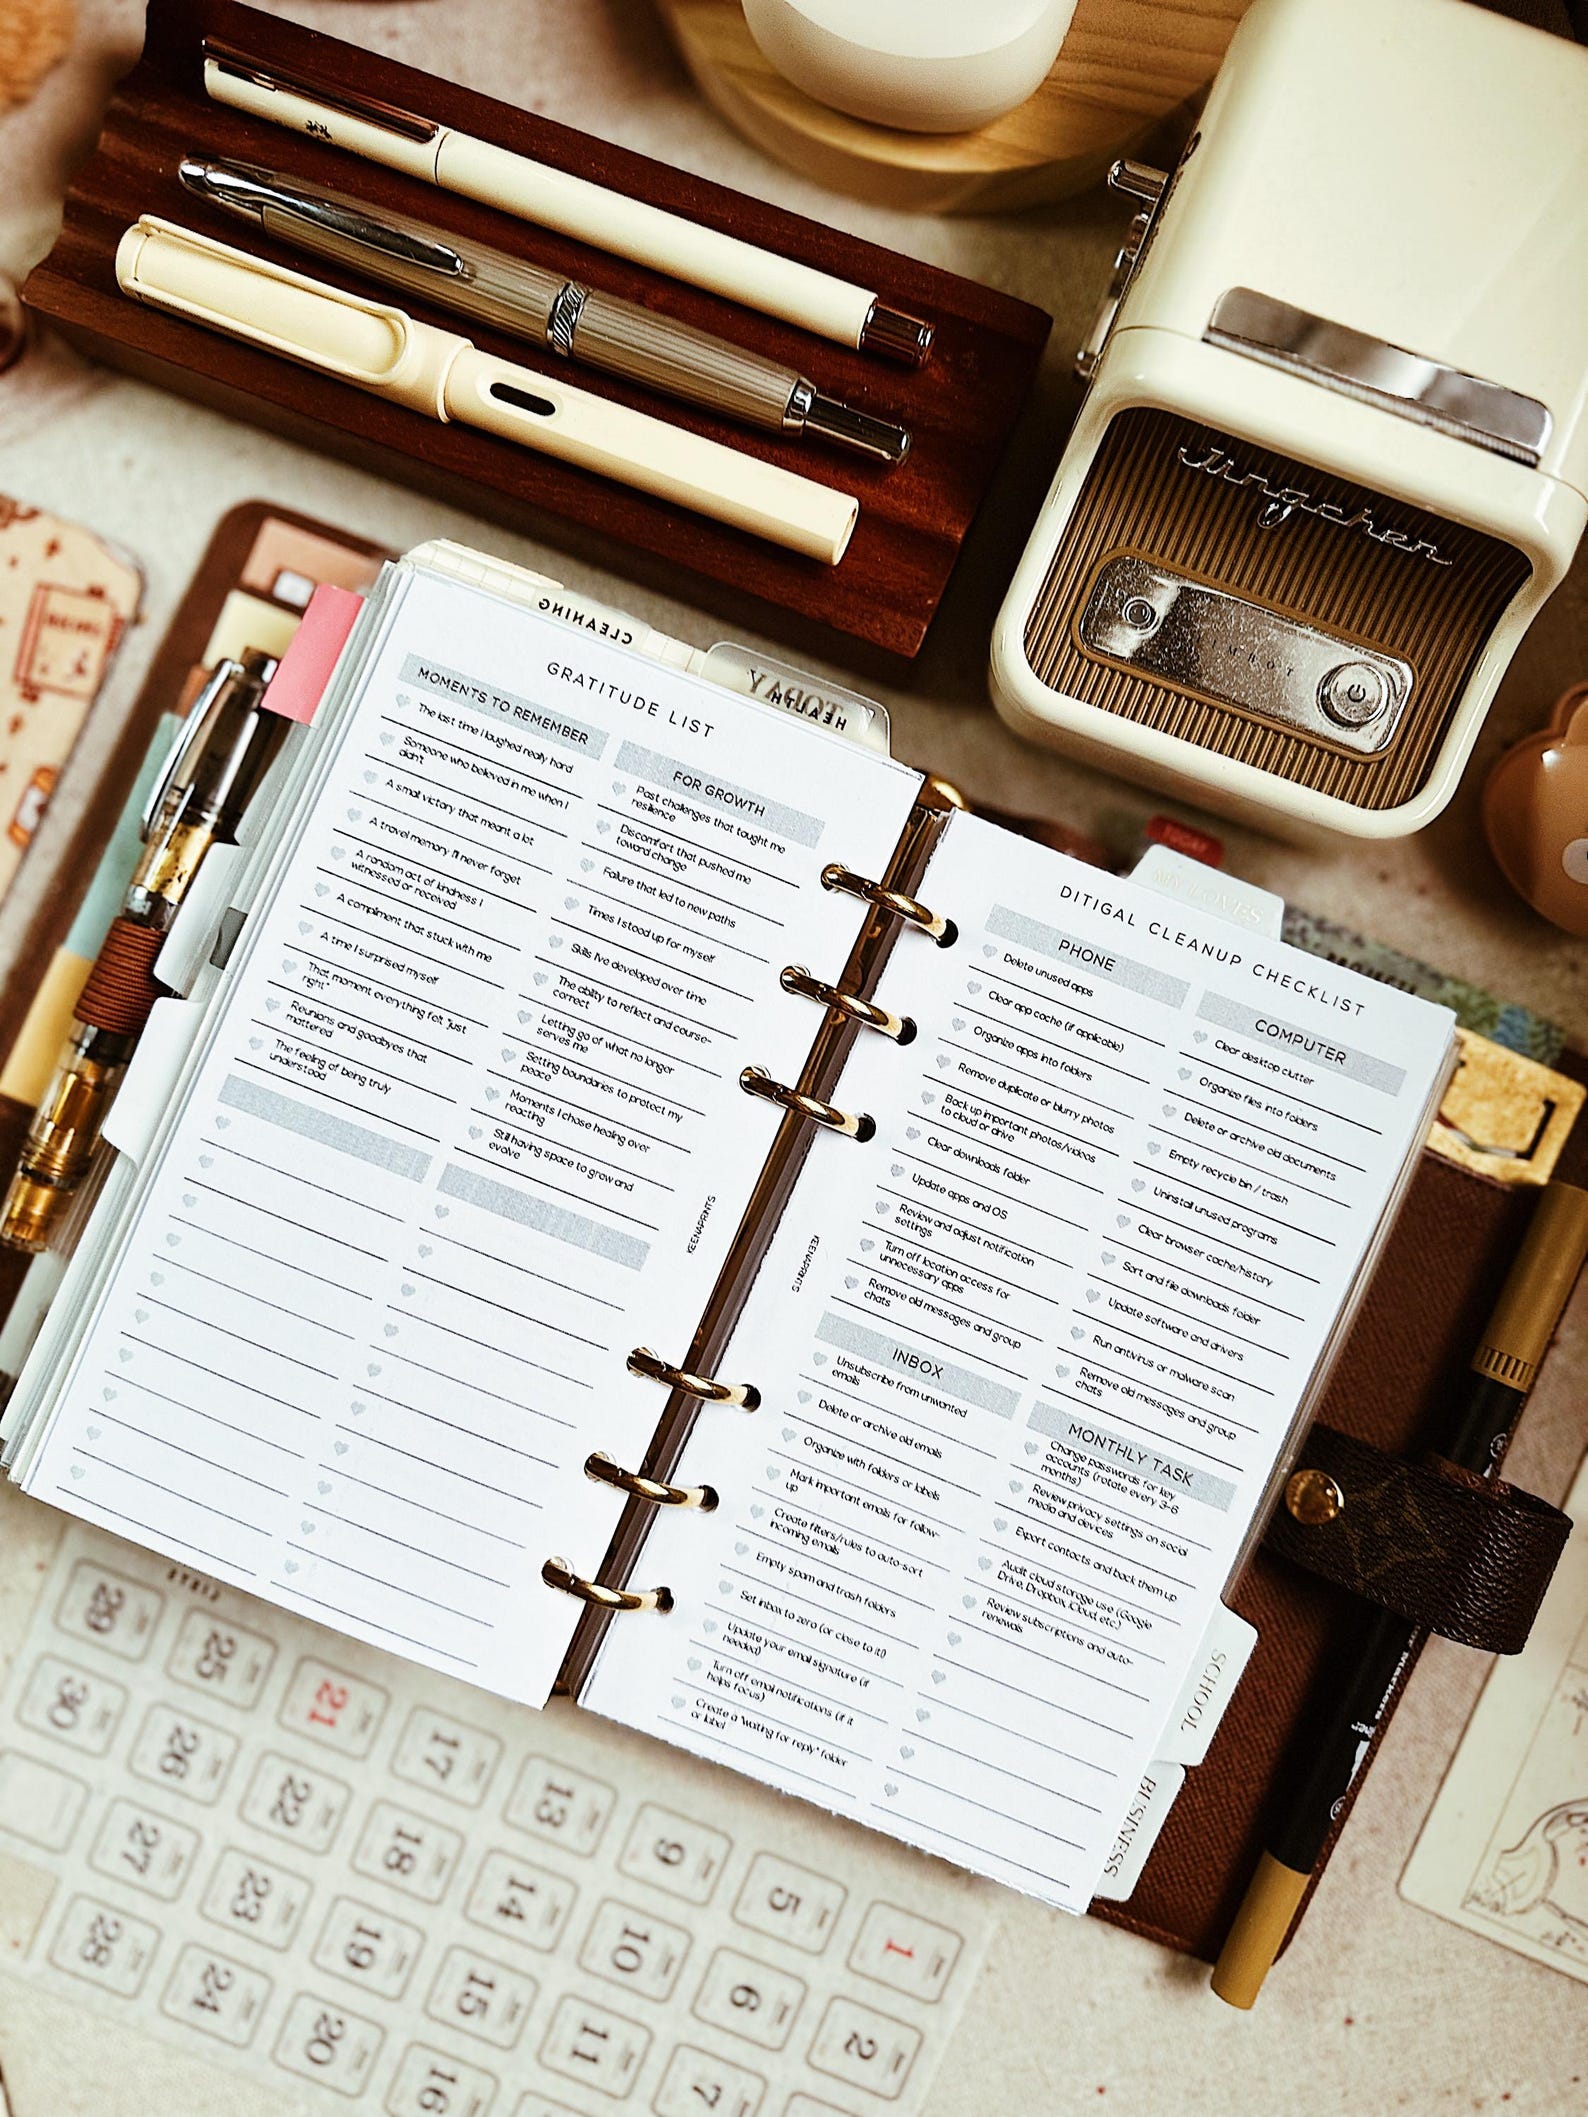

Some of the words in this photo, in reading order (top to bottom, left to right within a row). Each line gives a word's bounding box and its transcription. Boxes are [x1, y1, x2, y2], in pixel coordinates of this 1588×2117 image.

[418, 665, 489, 705] MOMENTS
[490, 694, 512, 714] TO
[511, 703, 590, 746] REMEMBER
[545, 660, 661, 718] GRATITUDE
[666, 708, 716, 739] LIST
[418, 701, 437, 718] The
[436, 711, 456, 727] last
[457, 719, 480, 735] time
[483, 729, 523, 753] laughed
[548, 756, 575, 774] hard
[670, 768, 704, 793] FOR
[702, 782, 767, 818] GROWTH
[635, 784, 661, 804] Past
[712, 816, 735, 834] that
[735, 826, 769, 848] taught
[768, 841, 786, 855] me
[615, 835, 652, 857] toward
[650, 851, 688, 873] change
[619, 822, 675, 854] Discomfort
[675, 846, 698, 864] that
[696, 856, 737, 879] pushed
[734, 871, 752, 886] me
[635, 879, 658, 897] that
[657, 888, 675, 903] led
[673, 895, 687, 908] to
[685, 901, 709, 917] new
[706, 910, 737, 929] paths
[1002, 952, 1035, 973] Delete
[1034, 967, 1072, 988] unused
[1069, 981, 1094, 998] apps
[1056, 937, 1118, 974] PHONE
[1058, 883, 1136, 928] DITIGAL
[1146, 920, 1244, 967] CLEANUP
[1250, 961, 1367, 1017] CHECKLIST
[285, 1012, 334, 1039] mattered
[289, 999, 335, 1026] Reunions
[336, 1020, 357, 1035] and
[355, 1028, 405, 1054] goodbyes
[405, 1047, 428, 1064] that
[535, 1026, 571, 1047] serves
[571, 1040, 589, 1054] me
[540, 1013, 577, 1039] Letting
[574, 1030, 591, 1043] go
[590, 1036, 605, 1046] of
[604, 1040, 630, 1058] what
[629, 1050, 644, 1063] no
[643, 1054, 676, 1075] longer
[1253, 1017, 1348, 1067] COMPUTER
[268, 1053, 327, 1082] understood
[275, 1037, 294, 1054] The
[326, 1062, 341, 1072] of
[339, 1065, 368, 1088] being
[367, 1077, 392, 1096] truly
[519, 1063, 552, 1083] peace
[972, 1024, 1016, 1050] Organize
[1014, 1044, 1039, 1060] apps
[1039, 1052, 1060, 1068] into
[1058, 1060, 1093, 1082] folders
[1213, 1038, 1241, 1056] Clear
[1240, 1051, 1281, 1073] desktop
[1280, 1067, 1315, 1085] clutter
[525, 1050, 561, 1076] Setting
[560, 1064, 615, 1094] boundaries
[615, 1087, 629, 1100] to
[627, 1093, 666, 1116] protect
[666, 1109, 684, 1124] my
[926, 1135, 954, 1153] Clear
[952, 1147, 1002, 1175] downloads
[1001, 1166, 1031, 1185] folder
[1183, 1110, 1216, 1132] Delete
[1215, 1126, 1229, 1136] or
[1228, 1131, 1266, 1152] archive
[1265, 1147, 1283, 1160] old
[1281, 1153, 1337, 1182] documents
[911, 1172, 947, 1195] Update
[946, 1189, 971, 1205] apps
[971, 1199, 993, 1214] and
[990, 1205, 1009, 1221] OS
[1152, 1185, 1195, 1210] Uninstall
[1193, 1204, 1232, 1226] unused
[1229, 1219, 1279, 1246] programs
[1136, 1223, 1165, 1241] Clear
[1107, 1296, 1144, 1319] Update
[1143, 1313, 1190, 1339] software
[1189, 1333, 1211, 1347] and
[1209, 1341, 1244, 1362] drivers
[835, 1354, 896, 1388] Unsubscribe
[894, 1380, 921, 1399] from
[919, 1391, 969, 1419] unwanted
[890, 1346, 945, 1381] INBOX
[817, 1398, 850, 1420] Delete
[849, 1414, 863, 1424] or
[861, 1419, 899, 1440] archive
[897, 1434, 915, 1447] old
[1066, 1421, 1149, 1466] MONTHLY
[1151, 1455, 1195, 1488] TASK
[1014, 1525, 1047, 1548] Export
[1046, 1541, 1092, 1566] contacts
[1092, 1560, 1114, 1575] and
[1111, 1566, 1136, 1586] back
[1136, 1578, 1164, 1597] them
[1163, 1590, 1178, 1603] up
[86, 1581, 126, 1635] 29
[196, 1629, 238, 1680] 25
[47, 1676, 88, 1731] 30
[307, 1679, 349, 1728] 21
[1180, 1648, 1227, 1732] SCHOOL
[159, 1726, 199, 1780] 26
[424, 1730, 462, 1781] 17
[269, 1774, 311, 1828] 22
[535, 1782, 575, 1829] 13
[121, 1820, 160, 1876] 27
[383, 1828, 423, 1876] 18
[654, 1838, 685, 1867] 9
[231, 1869, 271, 1923] 23
[496, 1877, 537, 1921] 14
[767, 1886, 802, 1915] 5
[80, 1914, 122, 1968] 28
[345, 1924, 382, 1971] 19
[612, 1927, 651, 1974] 10
[884, 1939, 915, 1959] 1
[192, 1963, 232, 2014] 24
[457, 1972, 496, 2017] 15
[729, 1984, 760, 2013] 6
[306, 2012, 344, 2066] 20
[571, 2023, 609, 2065] 11
[843, 2031, 877, 2062] 2
[419, 2068, 457, 2117] 16
[691, 2084, 723, 2110] 7
